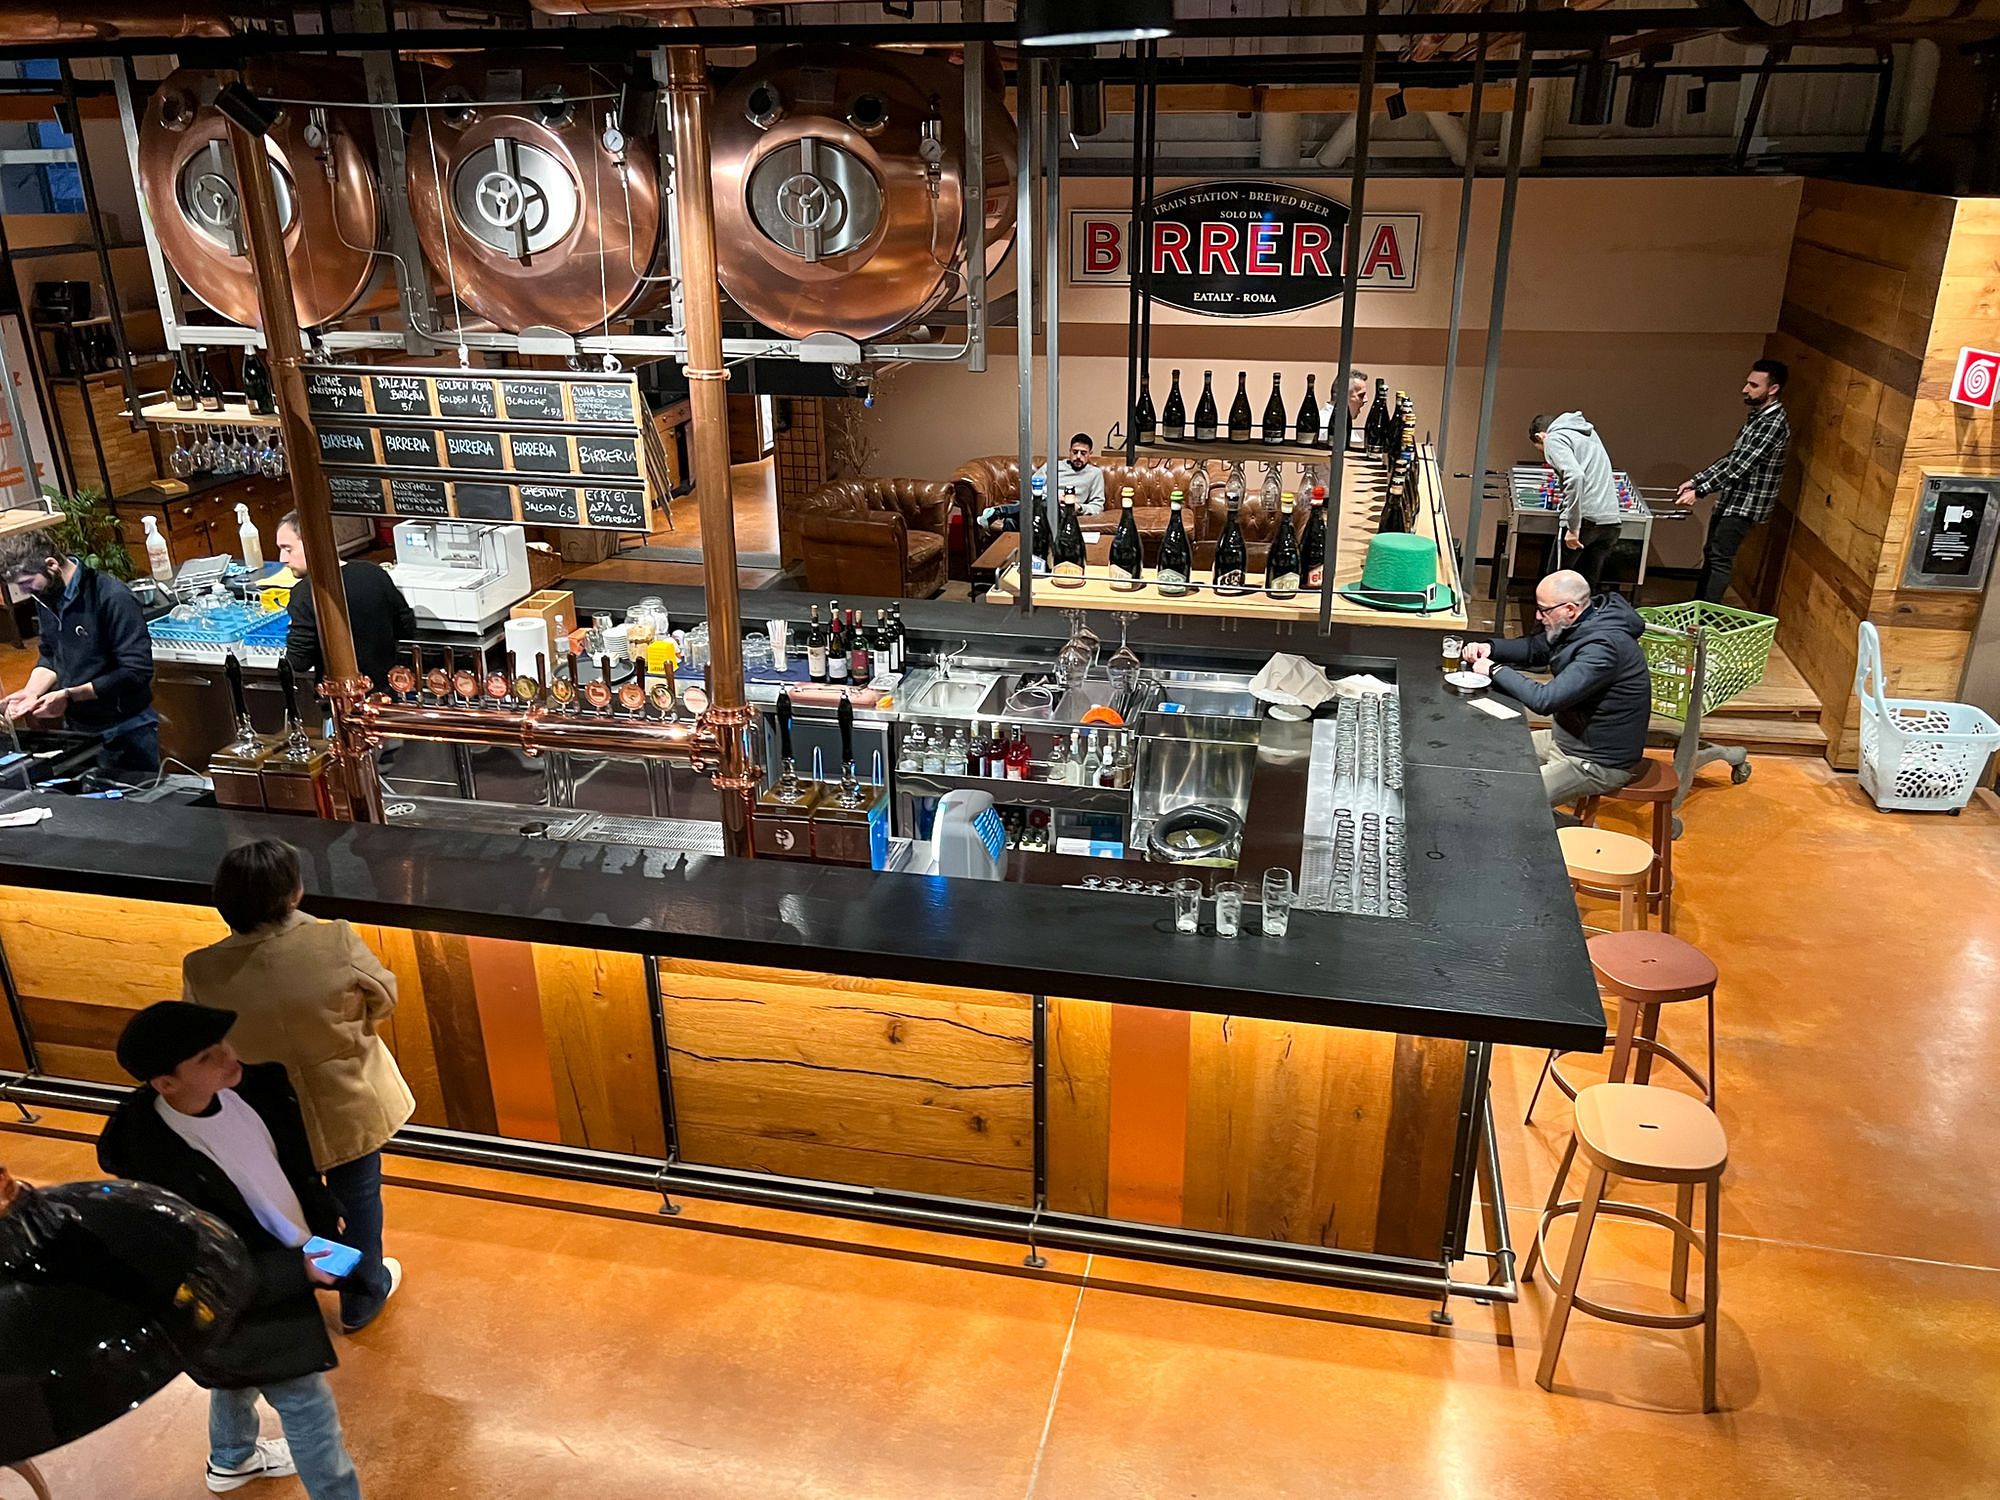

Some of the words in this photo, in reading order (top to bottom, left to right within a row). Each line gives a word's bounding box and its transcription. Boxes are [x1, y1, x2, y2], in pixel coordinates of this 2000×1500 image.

[1153, 198, 1187, 215] TRAIN
[1189, 191, 1238, 204] STATION
[1249, 191, 1297, 206] BREWED
[1299, 200, 1329, 217] BEER
[1220, 210, 1246, 219] SOLO
[1249, 210, 1263, 219] DA
[1193, 292, 1233, 303] EATALY
[1243, 292, 1277, 303] ROMA
[436, 380, 469, 391] GOLDEN
[471, 381, 494, 391] ROMA
[439, 394, 468, 405] GOLDEN
[471, 393, 489, 404] ALE
[505, 396, 547, 406] BLANCHE
[320, 433, 365, 450] BIRRERIA
[385, 434, 431, 453] BIRRERIA
[448, 438, 495, 456] BIRRERIA
[512, 441, 557, 457] BIRRERIA
[1929, 479, 1941, 490] 16
[520, 487, 567, 499] CHESTNUT
